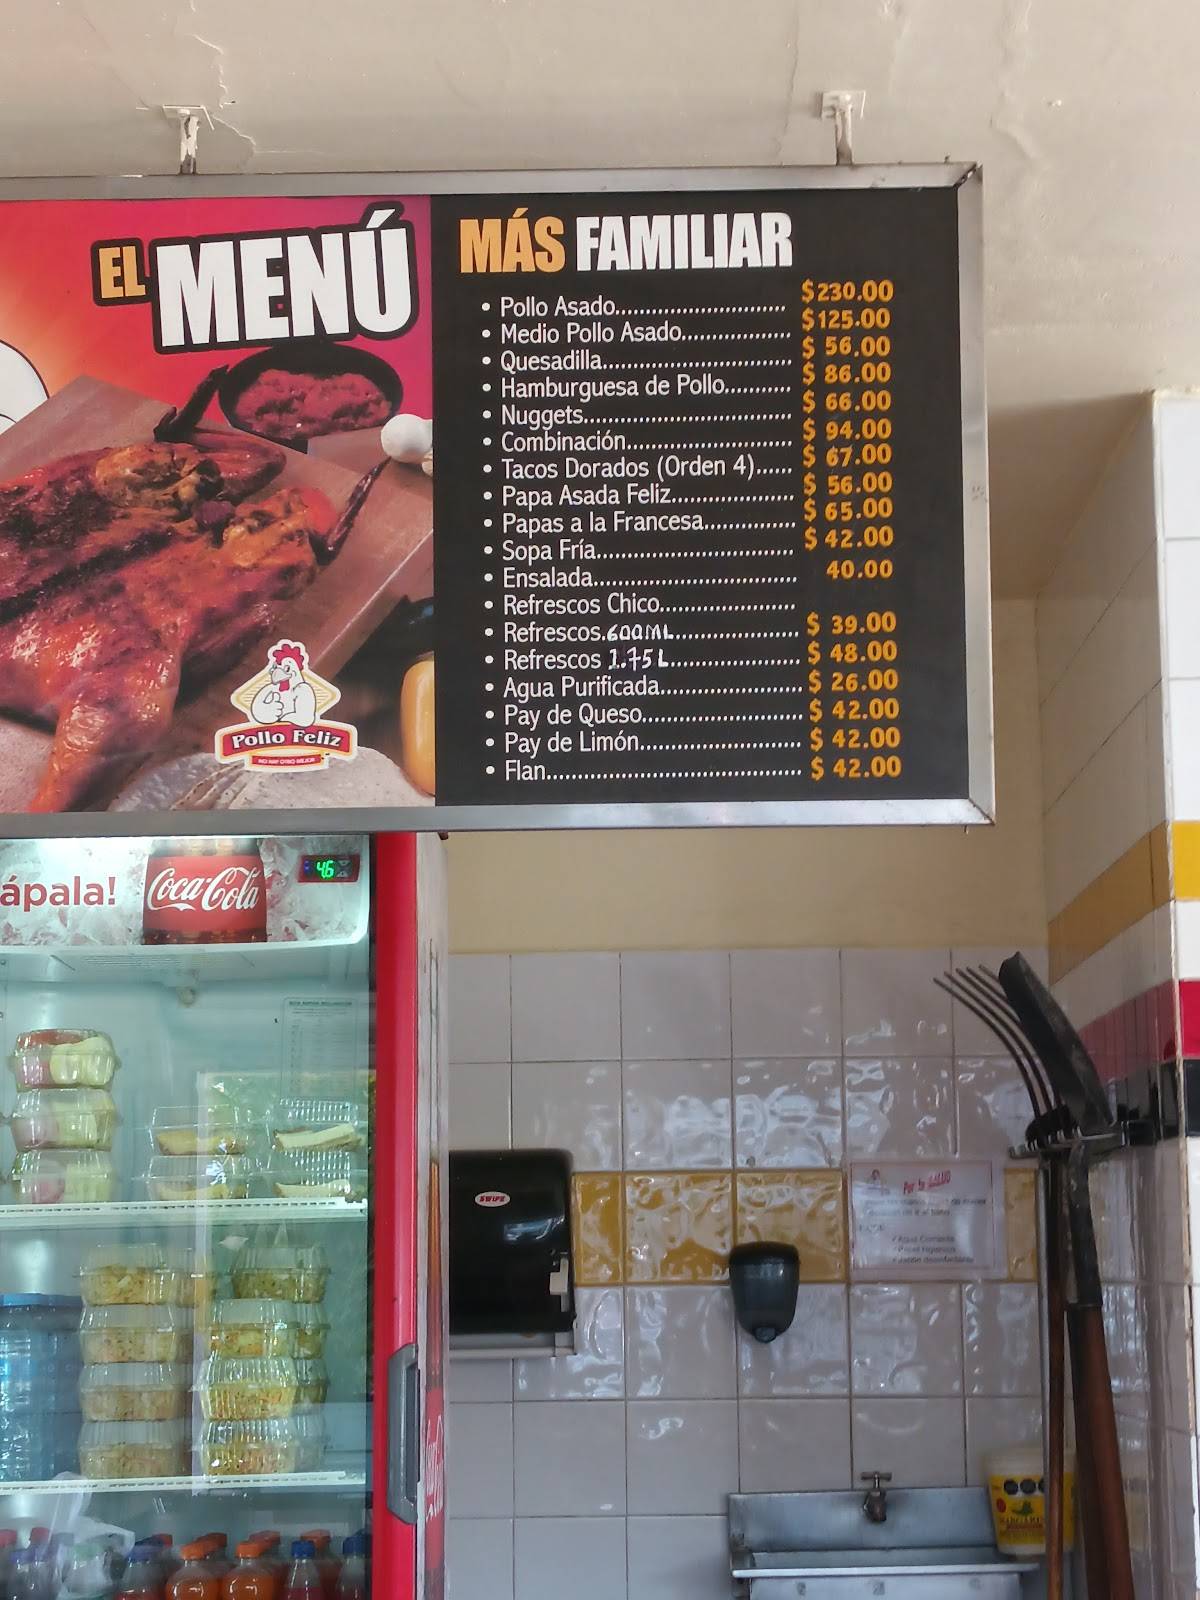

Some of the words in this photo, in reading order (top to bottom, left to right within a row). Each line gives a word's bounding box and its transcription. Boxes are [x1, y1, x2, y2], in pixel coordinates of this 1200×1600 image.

[459, 207, 566, 274] MÁS
[576, 212, 793, 272] FAMILIAR
[98, 246, 146, 299] EL
[156, 208, 412, 347] MENÚ
[501, 296, 548, 317] Pollo
[554, 295, 617, 316] Asado
[802, 280, 893, 304] $230.00
[502, 323, 559, 344] Medio
[567, 322, 614, 343] Pollo
[621, 320, 683, 342] Asado
[802, 307, 890, 331] $125.00
[501, 349, 604, 374] Quesadilla
[802, 336, 815, 359] $
[826, 336, 890, 357] 56.00
[502, 376, 639, 403] Hamburguesa
[645, 375, 670, 395] de
[678, 374, 726, 395] Pollo
[803, 362, 815, 385] $
[825, 362, 891, 384] 86.00
[502, 404, 585, 430] Nuggets
[803, 390, 815, 413] $
[826, 390, 891, 411] 66.00
[502, 430, 625, 452] Combinación
[803, 418, 816, 442] $
[826, 418, 891, 441] 94.00
[502, 459, 558, 479] Tacos
[566, 457, 649, 478] Dorados
[658, 455, 725, 482] (Orden
[733, 454, 754, 480] 4)
[803, 444, 816, 468] $
[826, 443, 892, 467] 67.00
[503, 486, 553, 510] Papa
[559, 484, 620, 505] Asada
[628, 483, 671, 504] Feliz
[804, 472, 816, 496] $
[828, 471, 892, 495] 56.00
[503, 513, 564, 537] Papas
[571, 517, 583, 532] a
[590, 511, 606, 532] la
[614, 511, 704, 531] Francesa
[804, 498, 816, 522] $
[826, 497, 893, 521] 65.00
[503, 540, 552, 566] Sopa
[560, 539, 598, 560] Fría
[805, 527, 817, 550] $
[825, 527, 893, 548] 42.00
[504, 566, 595, 588] Ensalada
[827, 559, 893, 579] 40.00
[504, 594, 600, 615] Refrescos
[608, 592, 661, 613] Chico
[807, 612, 820, 636] $
[832, 611, 896, 634] 39.00
[505, 649, 601, 670] Refrescos
[808, 641, 821, 665] $
[830, 640, 897, 663] 48.00
[504, 677, 554, 703] Agua
[562, 675, 660, 696] Purificada
[809, 669, 821, 694] $
[832, 669, 899, 692] 26.00
[505, 704, 540, 731] Pay
[547, 704, 572, 725] de
[579, 703, 644, 727] Queso
[810, 698, 822, 722] $
[832, 698, 899, 720] 42.00
[231, 731, 285, 748] Pollo
[293, 729, 342, 747] Feliz
[505, 732, 541, 759] Pay
[548, 731, 572, 752] de
[580, 730, 638, 752] Limón
[810, 727, 823, 752] $
[832, 727, 901, 749] 42.00
[506, 760, 545, 781] Flan
[811, 756, 824, 781] $
[833, 756, 901, 778] 42.00
[0, 874, 116, 912] ápala!
[147, 867, 260, 912] Coca-Cola
